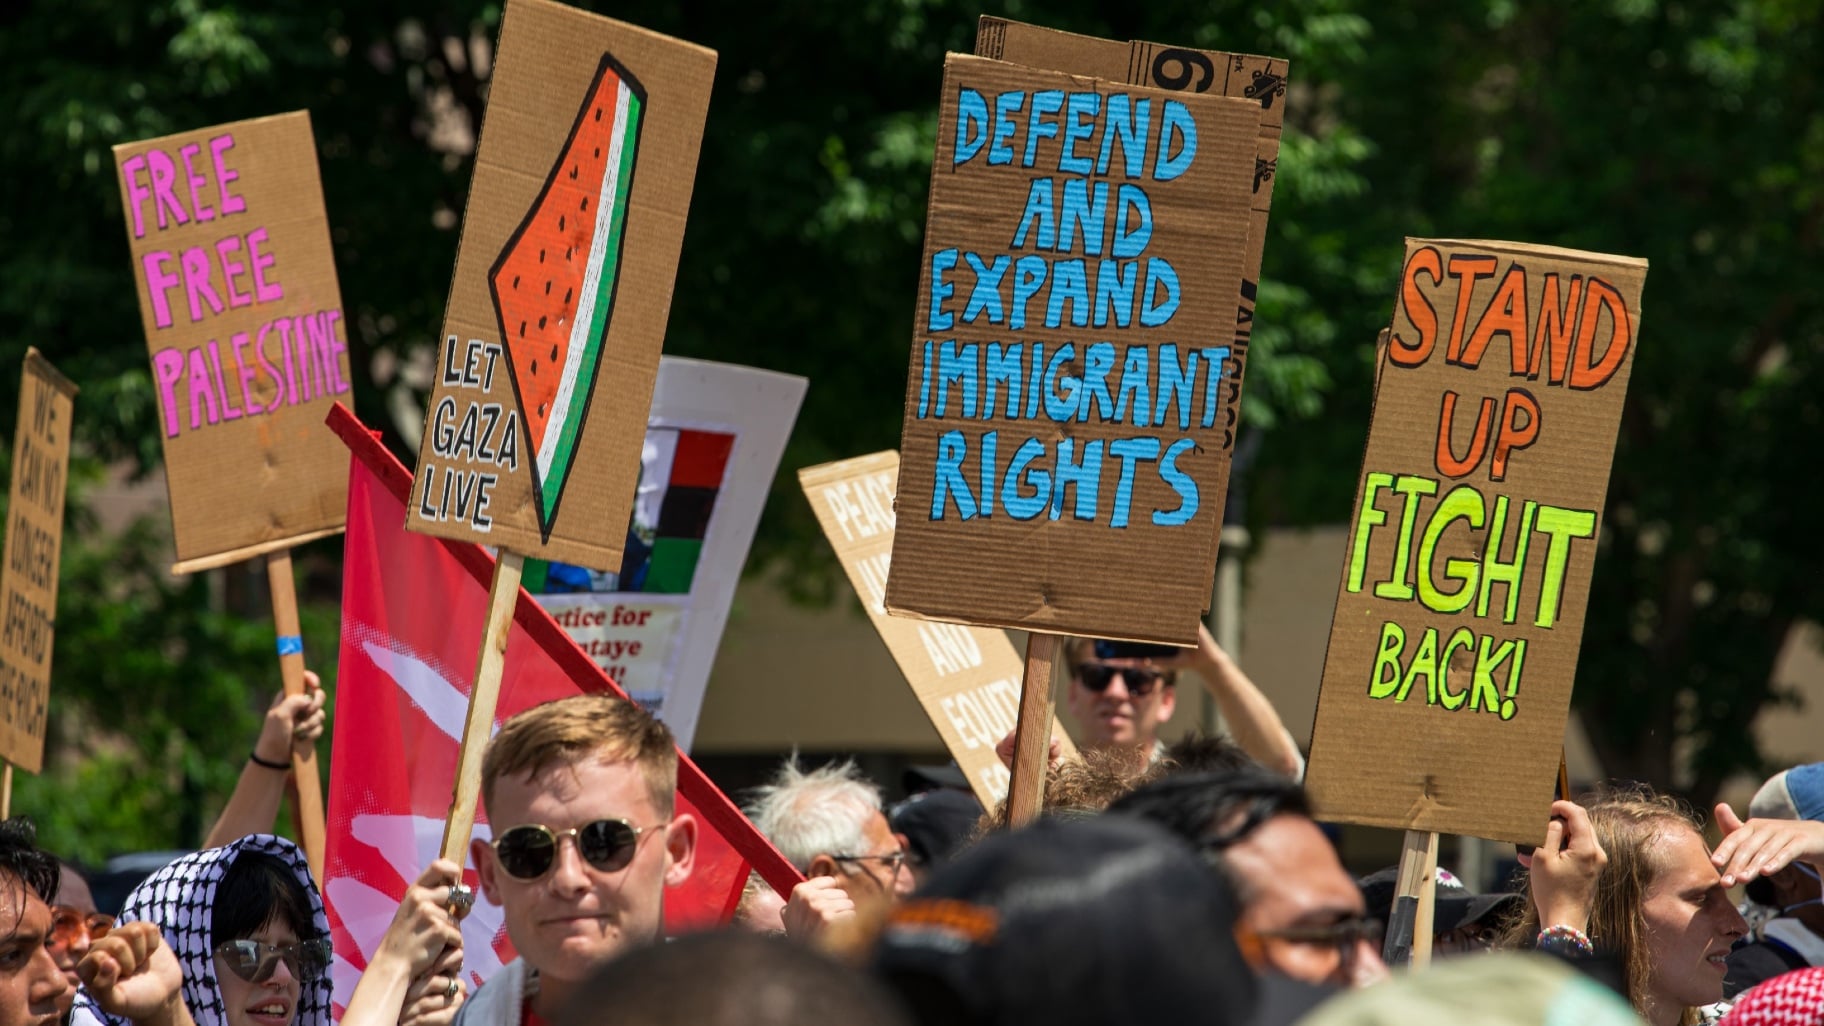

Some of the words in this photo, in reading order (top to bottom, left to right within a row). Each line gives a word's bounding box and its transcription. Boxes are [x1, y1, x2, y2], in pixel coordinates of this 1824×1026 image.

[1233, 55, 1245, 73] ork
[952, 83, 1198, 182] DEFEND
[122, 133, 247, 239] FREE
[1010, 176, 1154, 259] AND
[142, 227, 283, 329] FREE
[927, 247, 1181, 333] EXPAND
[1389, 246, 1632, 391] STAND
[152, 309, 350, 438] PALESTINE
[443, 335, 503, 393] LET
[917, 339, 1232, 431] IMMIGRANT
[432, 395, 518, 472] GAZA
[1435, 387, 1542, 481] UP
[419, 464, 498, 532] LIVE
[928, 429, 1201, 528] RIGHTS
[1347, 471, 1598, 630] FIGHT
[554, 606, 606, 628] stice
[611, 604, 652, 627] for
[580, 639, 642, 660] ntaye
[917, 621, 982, 677] AND
[1368, 621, 1528, 721] BACK!
[979, 763, 1010, 804] FO
